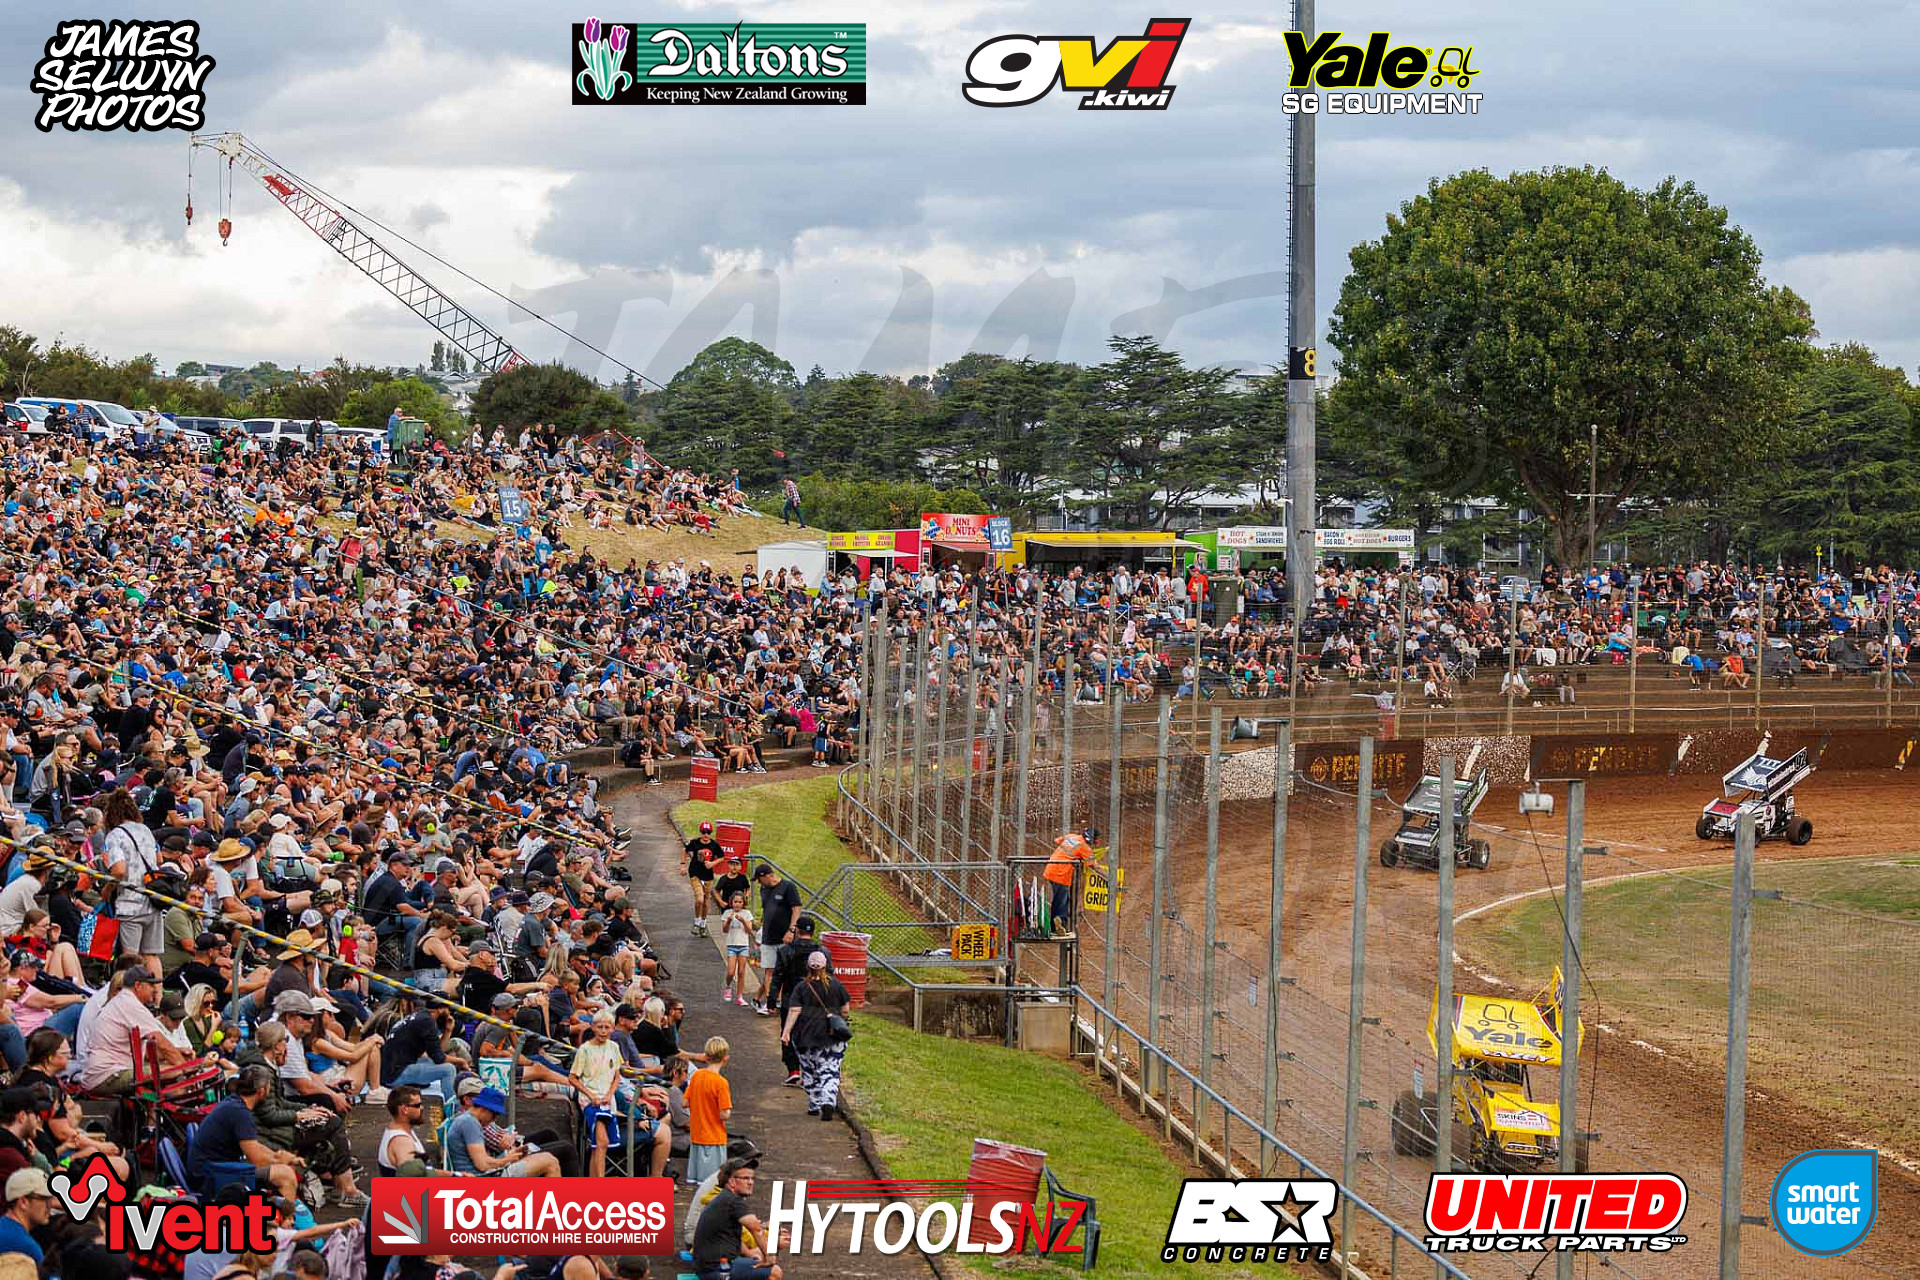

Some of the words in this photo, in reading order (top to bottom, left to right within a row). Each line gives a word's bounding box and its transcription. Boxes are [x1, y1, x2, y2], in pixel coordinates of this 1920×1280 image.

[1305, 350, 1316, 376] 8
[504, 499, 522, 518] 15
[953, 517, 970, 526] MINI
[992, 529, 1011, 546] 16
[1387, 534, 1411, 542] BURGERS
[961, 933, 973, 955] PACK
[973, 929, 984, 959] WHEEL
[1463, 1025, 1554, 1050] Yale
